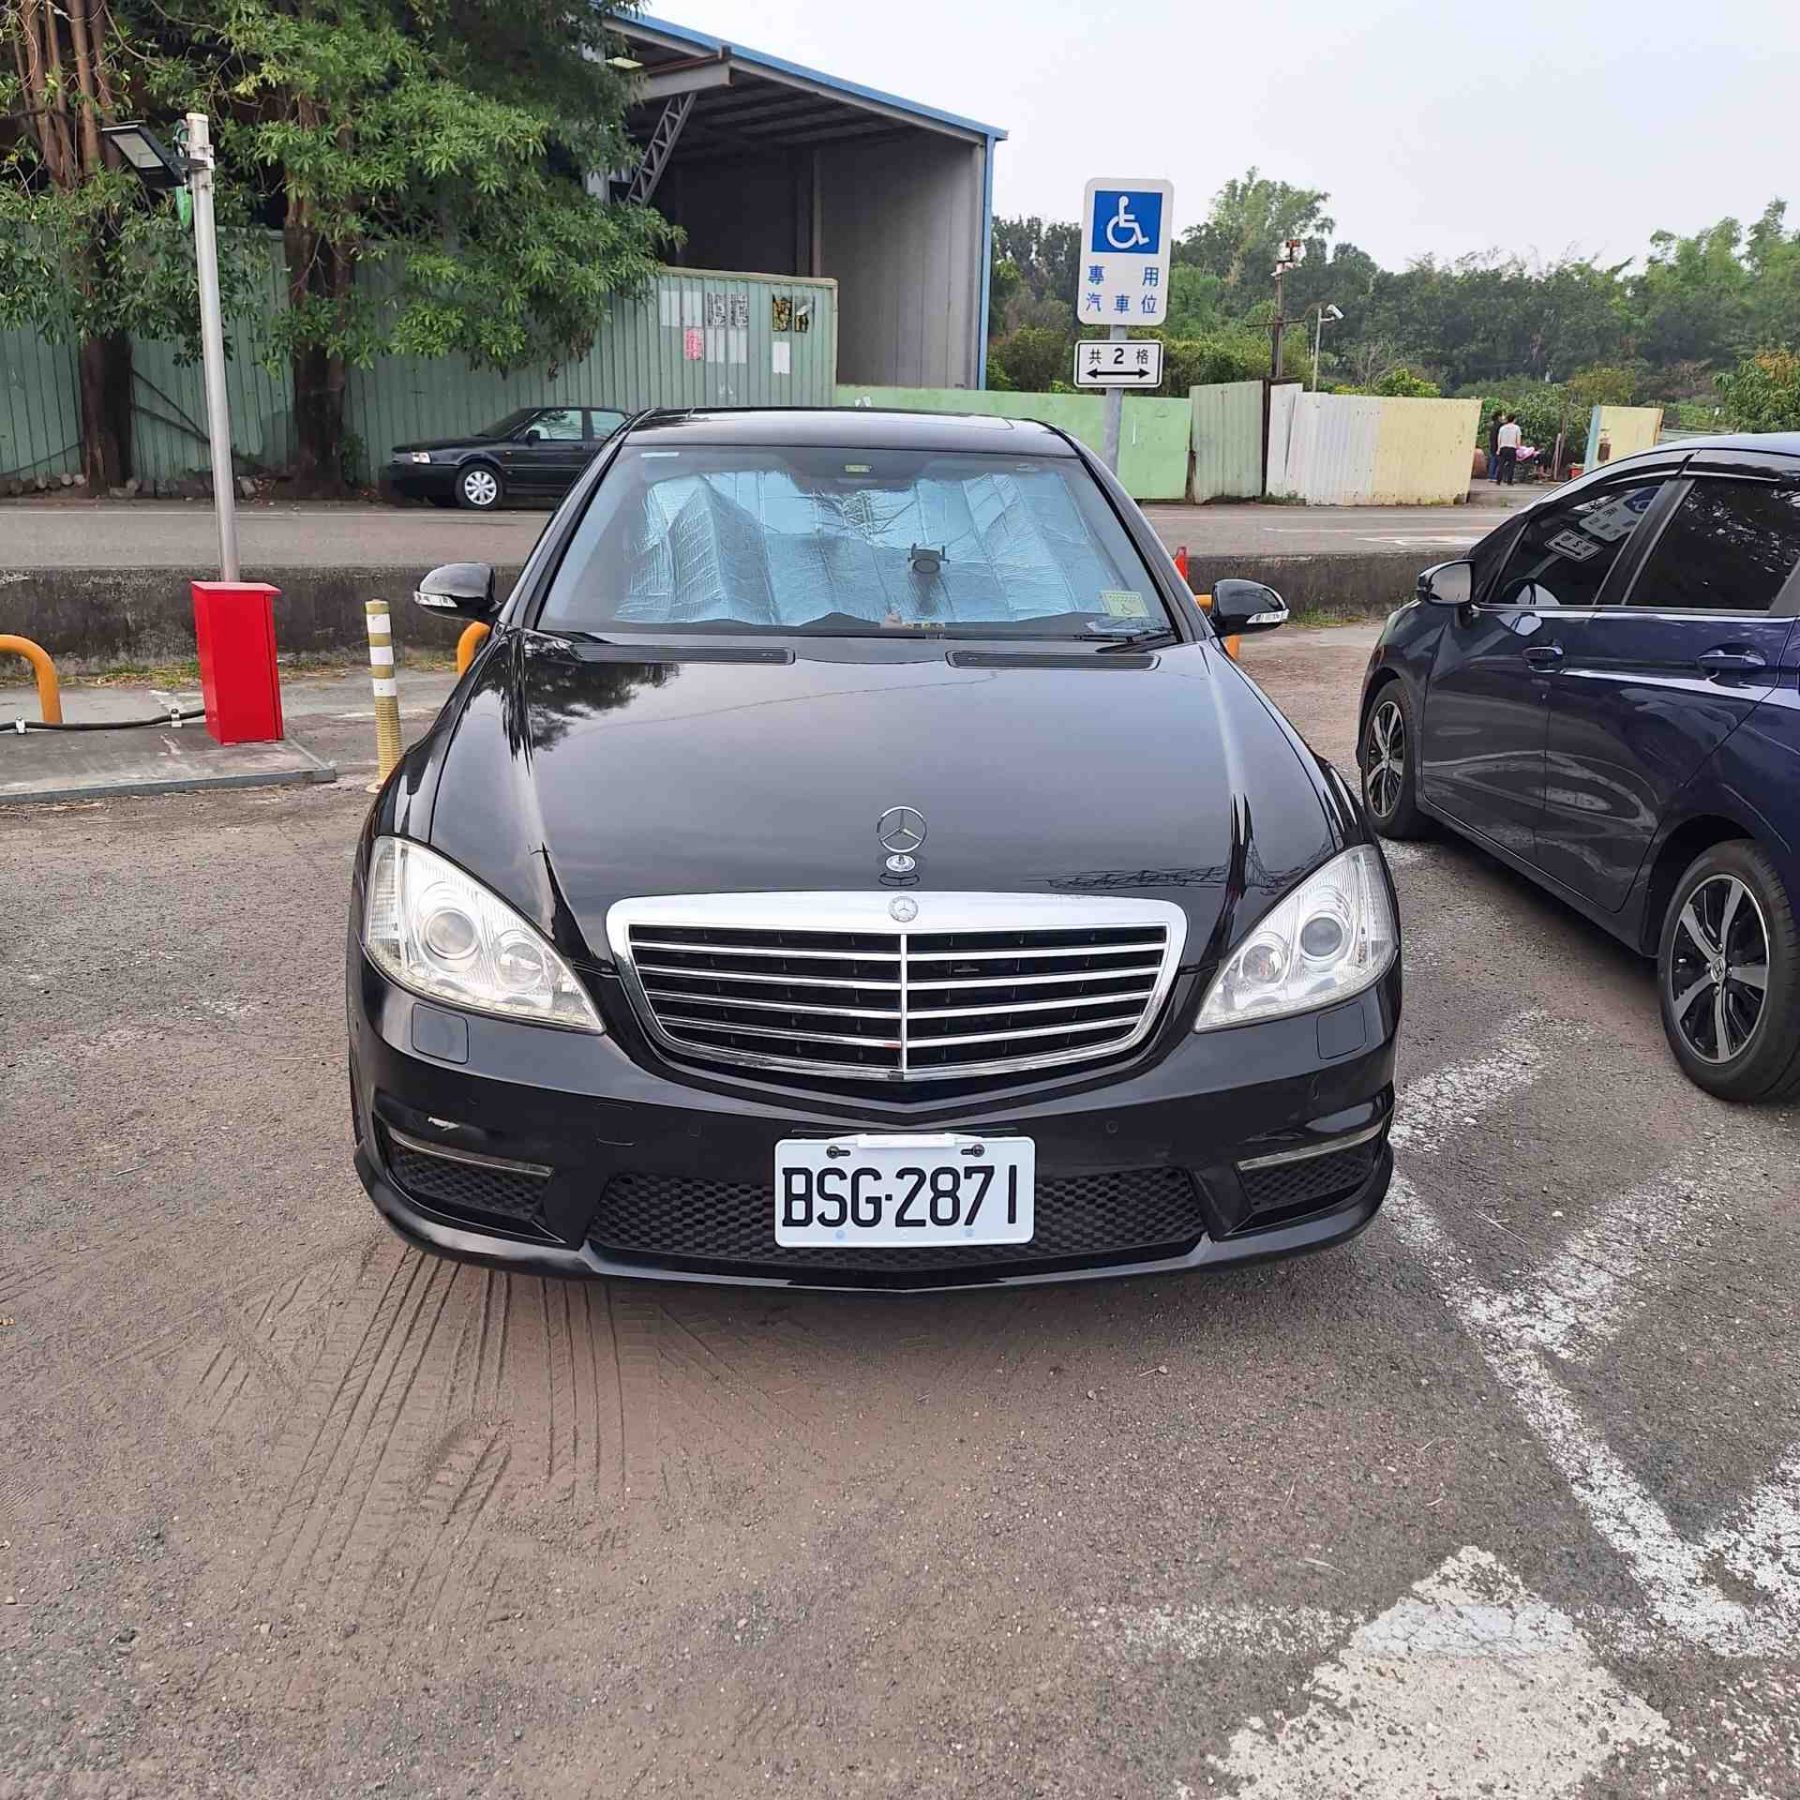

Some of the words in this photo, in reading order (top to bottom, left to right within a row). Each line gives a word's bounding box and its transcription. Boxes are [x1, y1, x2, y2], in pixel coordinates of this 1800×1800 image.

[1088, 265, 1159, 287] 專用
[1085, 292, 1157, 314] 汽車位
[1089, 347, 1149, 365] 共2格
[782, 1164, 1018, 1227] BSG-2871
